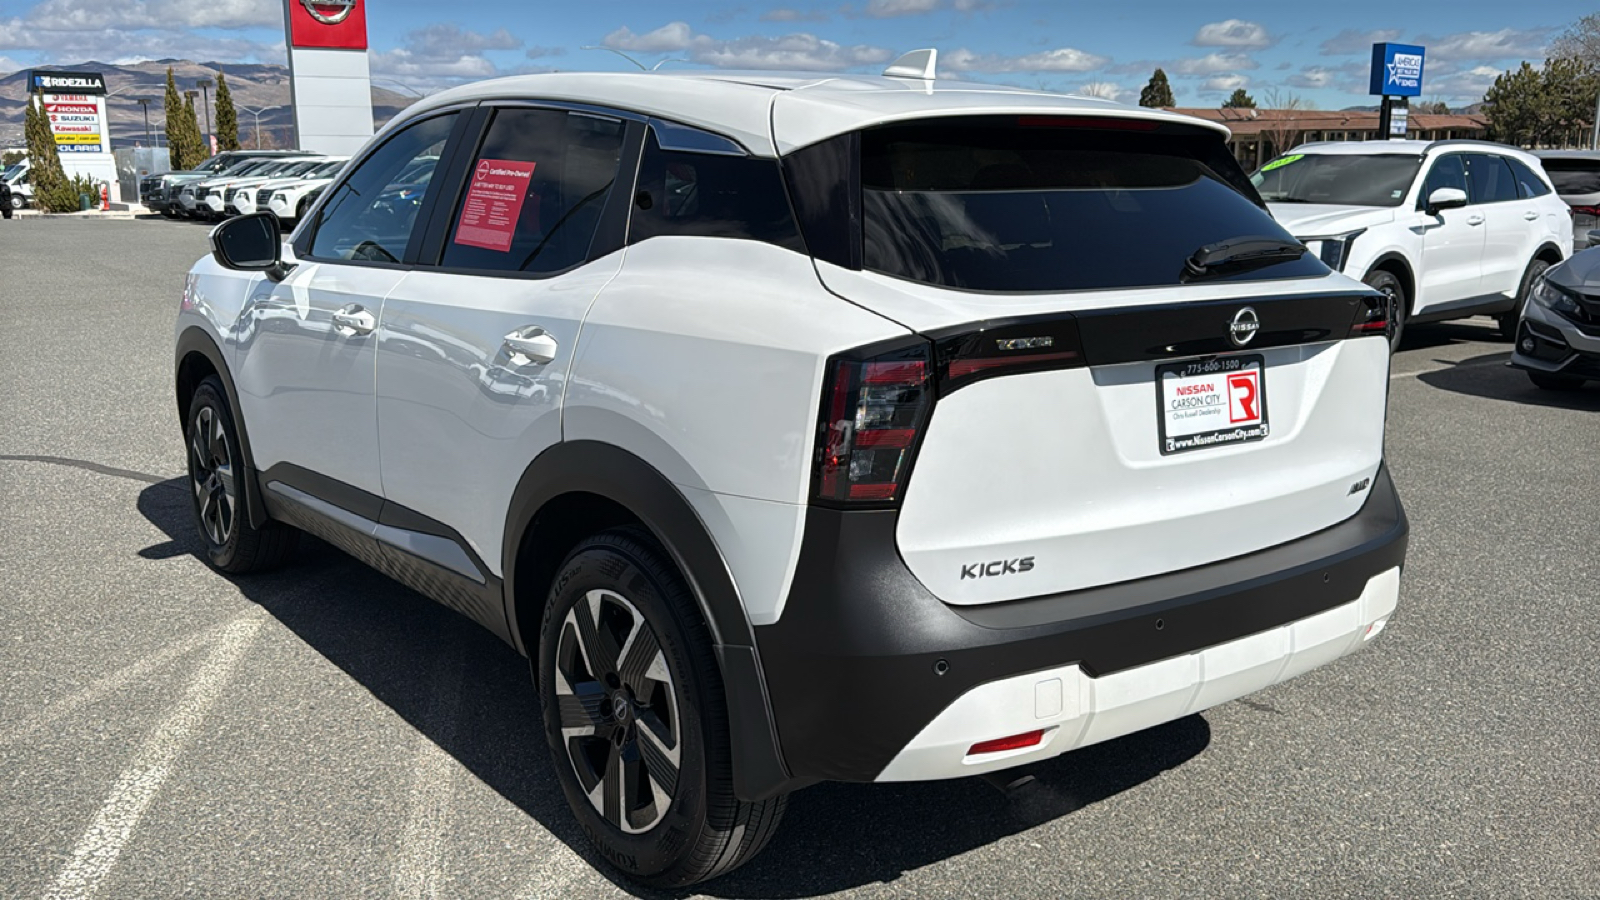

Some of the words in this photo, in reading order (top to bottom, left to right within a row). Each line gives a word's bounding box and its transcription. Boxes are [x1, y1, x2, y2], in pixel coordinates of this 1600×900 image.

[51, 78, 102, 87] RIDEZILLA
[1230, 323, 1260, 331] NISSAN
[1187, 360, 1240, 374] 775-600-1500
[1176, 384, 1215, 396] NISSAN
[1171, 397, 1203, 409] CARSON
[1205, 394, 1221, 405] CITY
[1175, 429, 1260, 448] www.NissanCarsonCity.com
[960, 556, 1035, 580] KICKS
